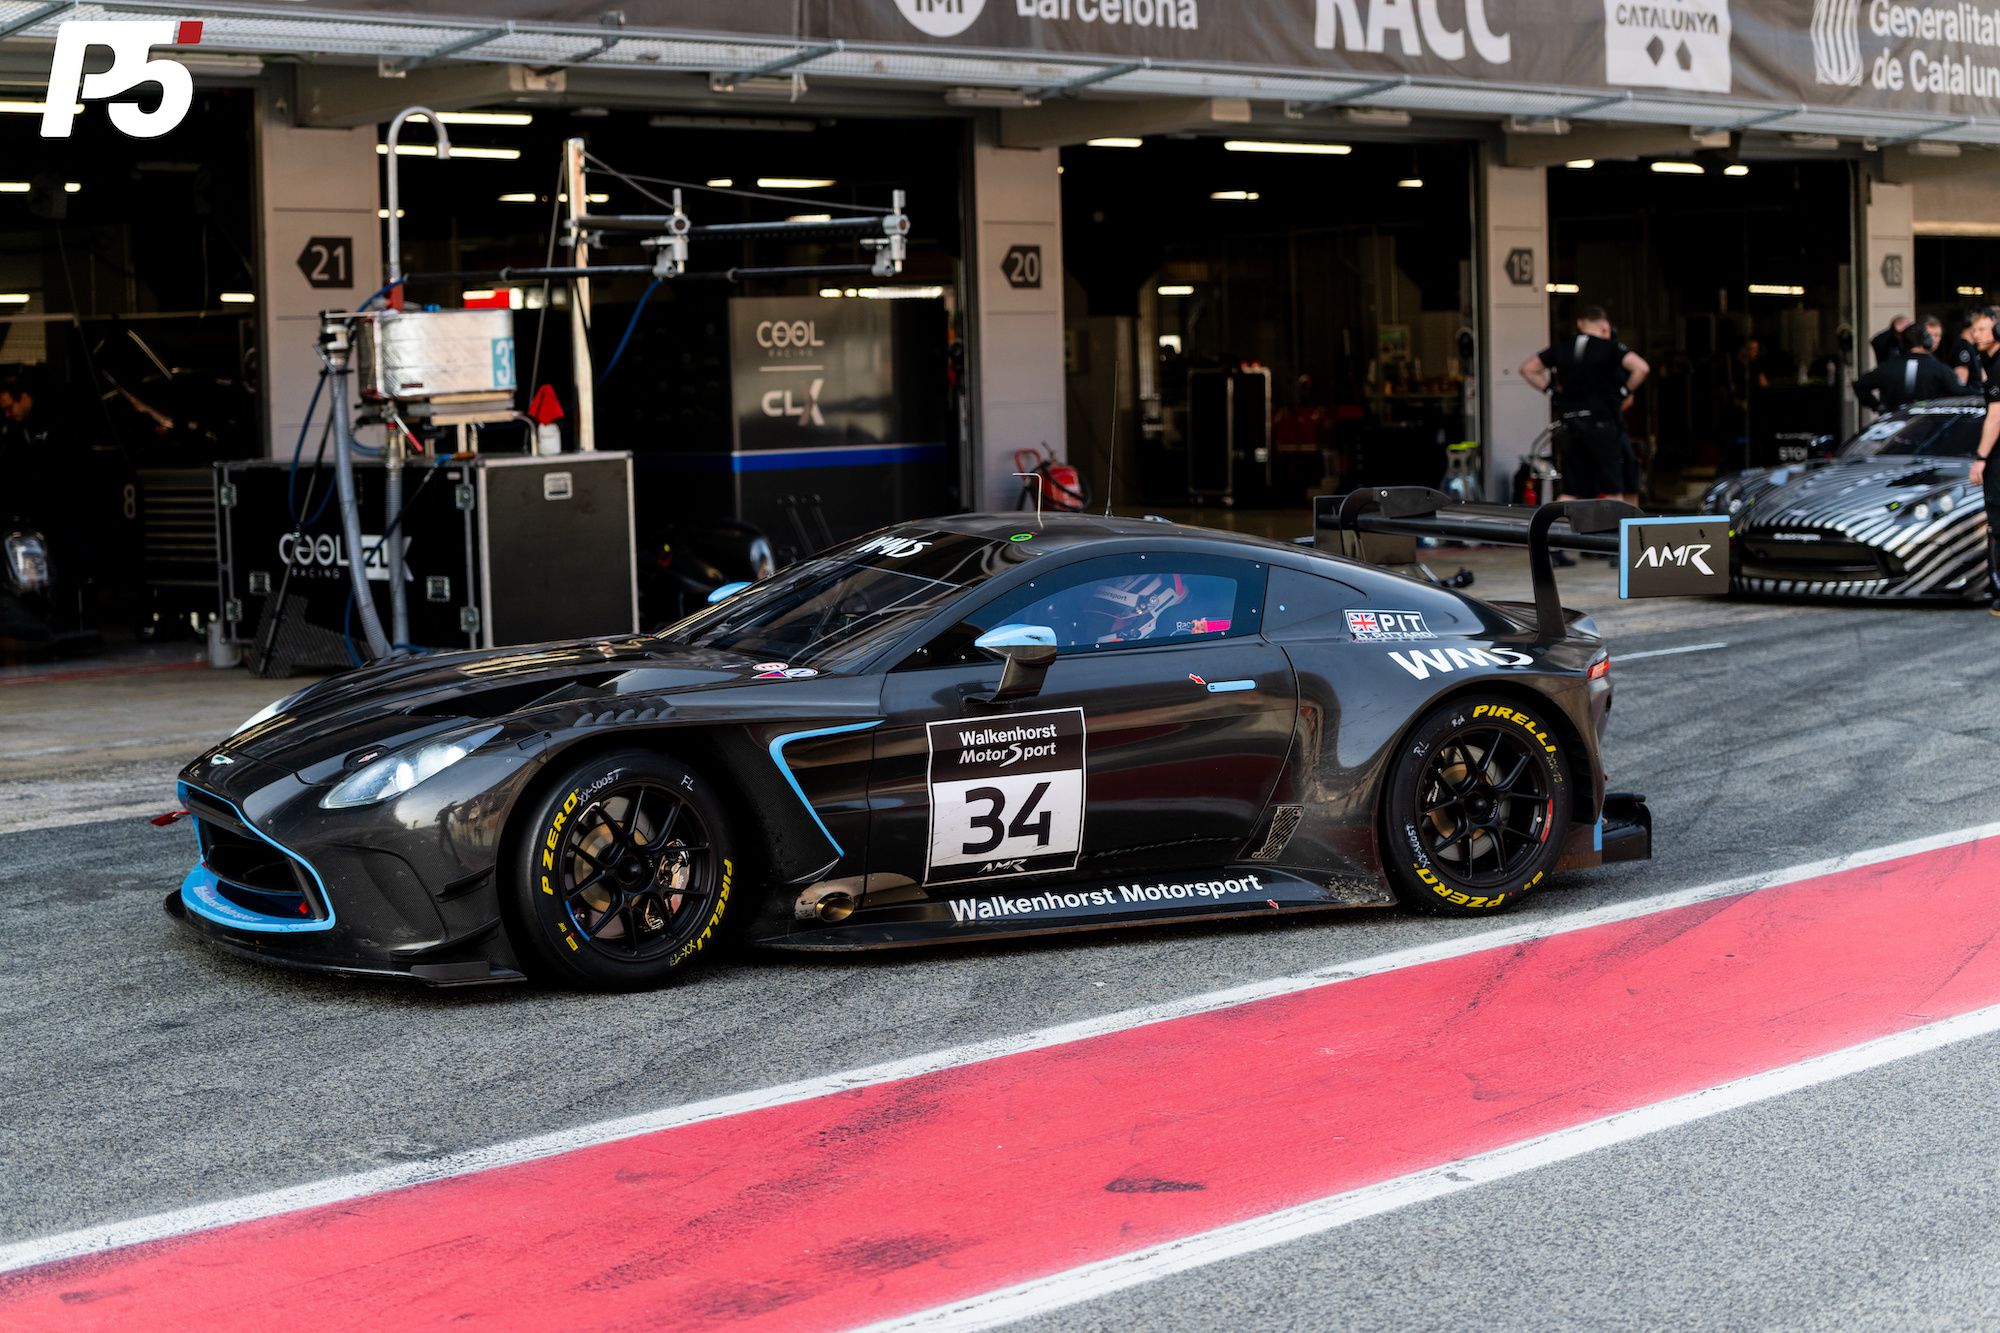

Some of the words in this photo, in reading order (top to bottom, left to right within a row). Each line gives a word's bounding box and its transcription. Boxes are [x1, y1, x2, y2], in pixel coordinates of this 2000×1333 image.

[1616, 4, 1718, 35] CATALUNYA
[1869, 0, 2000, 47] Generalitat
[1872, 47, 1904, 91] de
[311, 244, 346, 281] 21
[1010, 251, 1040, 283] 20
[1510, 253, 1533, 282] 19
[1885, 258, 1901, 284] 18
[756, 320, 825, 348] COOL
[761, 377, 826, 427] CLX
[278, 533, 350, 567] COOL
[1634, 544, 1715, 576] AMR
[291, 567, 341, 579] RACING
[1372, 632, 1432, 640] PITTARD
[1379, 613, 1421, 633] PIT
[1387, 647, 1534, 681] WMS
[959, 724, 1057, 747] Walkenhorst
[1472, 704, 1558, 753] PIRELLI
[958, 742, 1057, 768] MotorSport
[680, 774, 694, 792] FL
[542, 791, 578, 871] ZERO
[962, 781, 1052, 855] 34
[977, 858, 1028, 874] AMR
[696, 858, 734, 951] PIRELLI
[949, 887, 1117, 922] Walkenhorst
[1118, 874, 1264, 903] Motorsport
